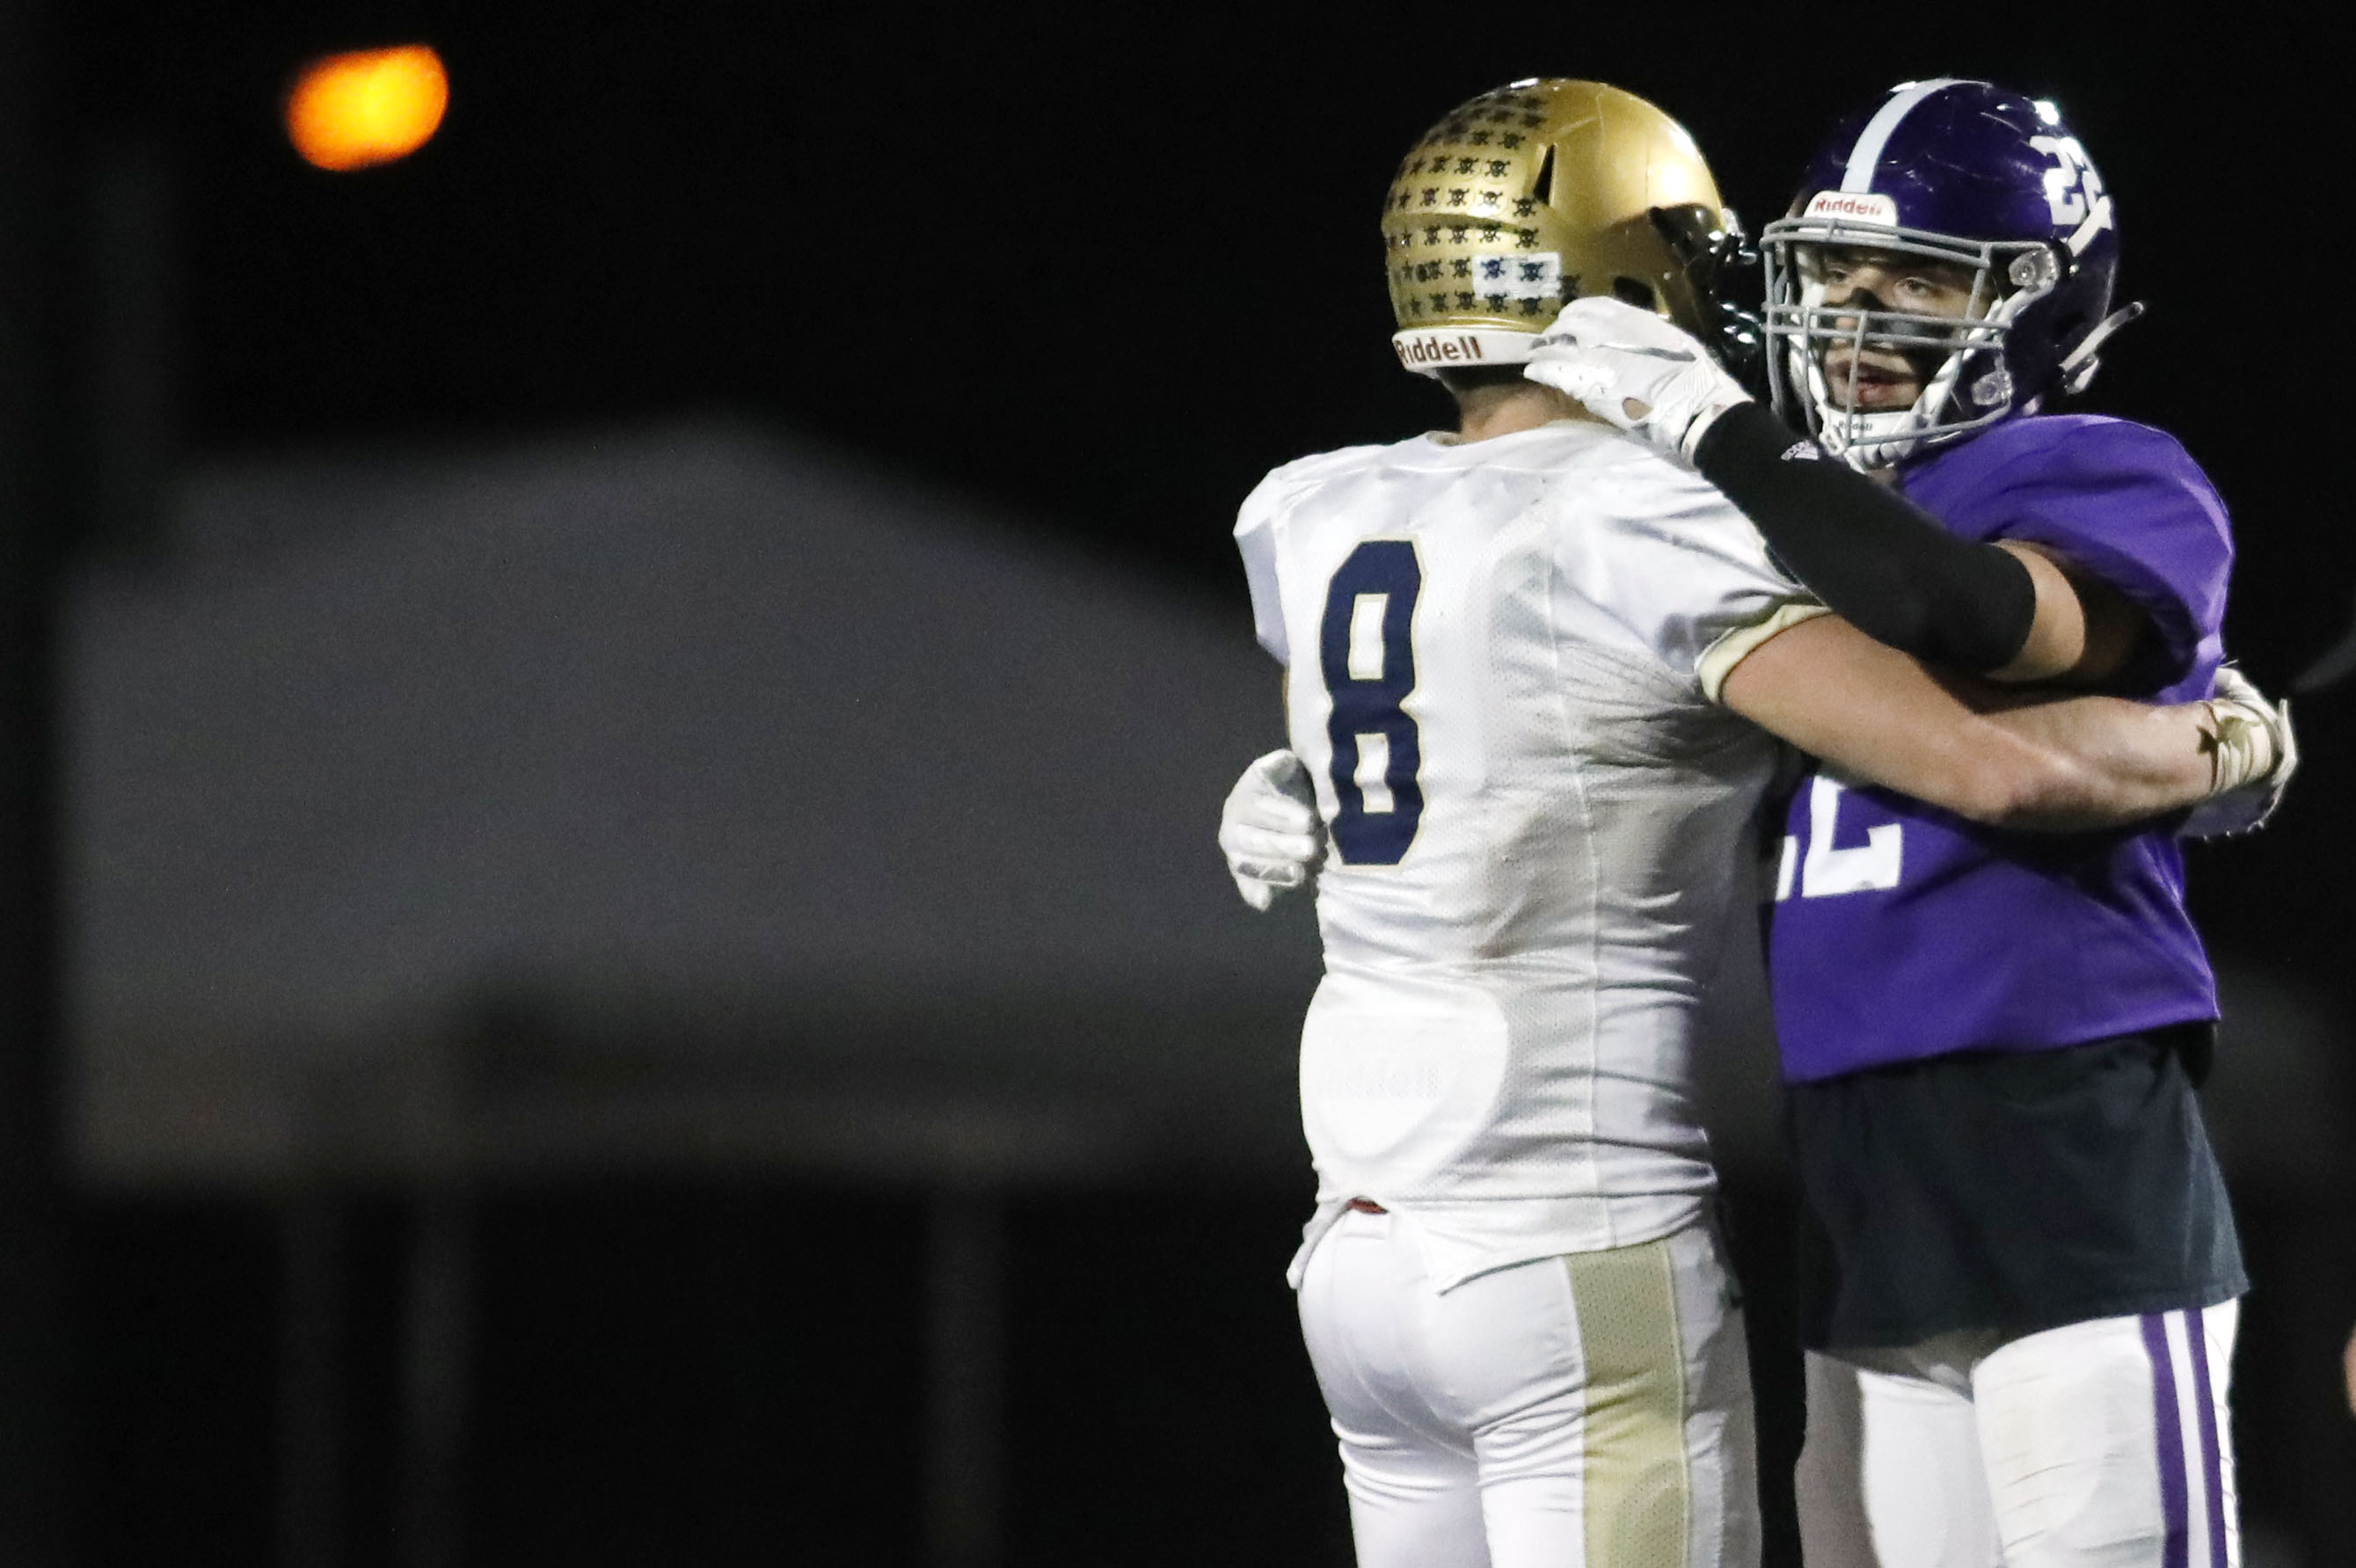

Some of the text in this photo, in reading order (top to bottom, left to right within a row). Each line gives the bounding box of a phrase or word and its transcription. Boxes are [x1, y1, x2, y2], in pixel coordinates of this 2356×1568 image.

[1814, 197, 1883, 217] Riddell
[1393, 335, 1483, 364] Riddell
[1319, 538, 1426, 869] 8
